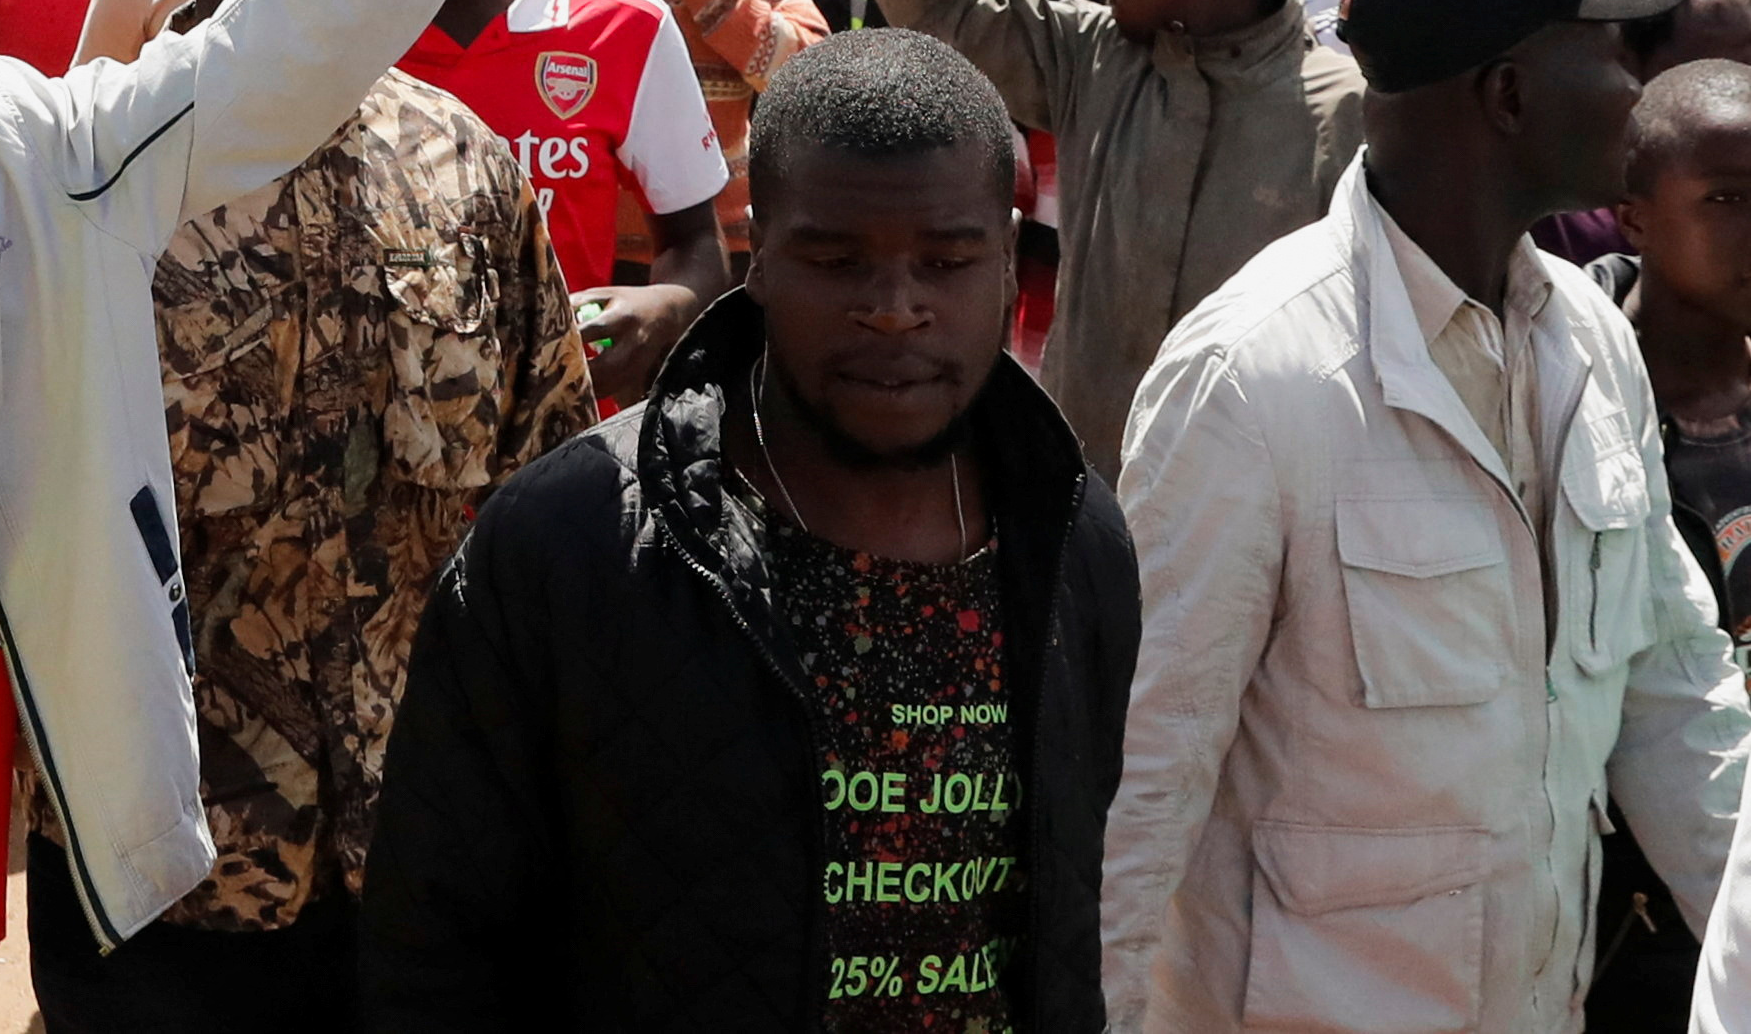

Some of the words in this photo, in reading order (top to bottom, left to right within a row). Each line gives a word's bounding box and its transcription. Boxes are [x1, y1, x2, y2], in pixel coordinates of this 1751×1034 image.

[548, 62, 589, 78] Arsenal
[495, 129, 589, 179] tes
[891, 703, 954, 725] SHOP
[960, 702, 1009, 724] NOW
[919, 773, 1023, 814] JOLL
[824, 856, 1016, 904] CHECKOUT
[828, 956, 903, 999] 25%
